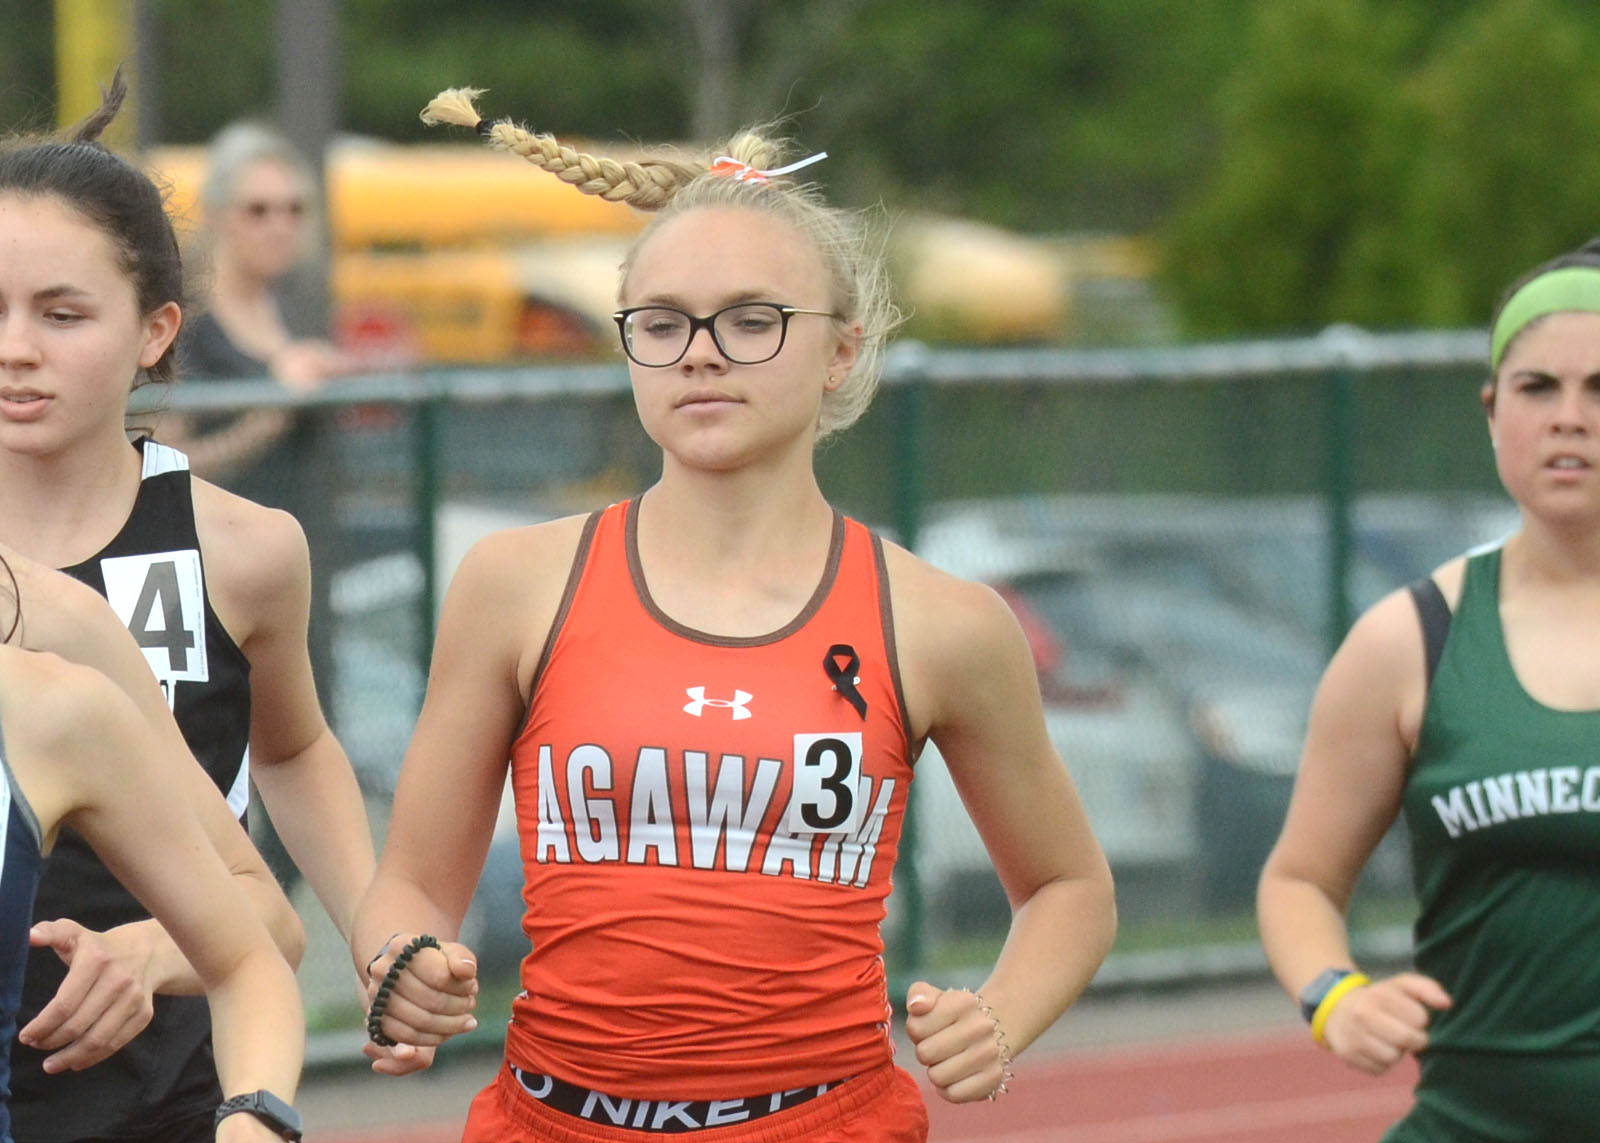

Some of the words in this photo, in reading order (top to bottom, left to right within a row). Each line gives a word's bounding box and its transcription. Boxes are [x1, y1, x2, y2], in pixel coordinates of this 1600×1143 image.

[127, 561, 195, 672] 4
[801, 738, 854, 830] 3
[1431, 765, 1600, 838] MINNEC
[580, 1089, 750, 1130] NIKE
